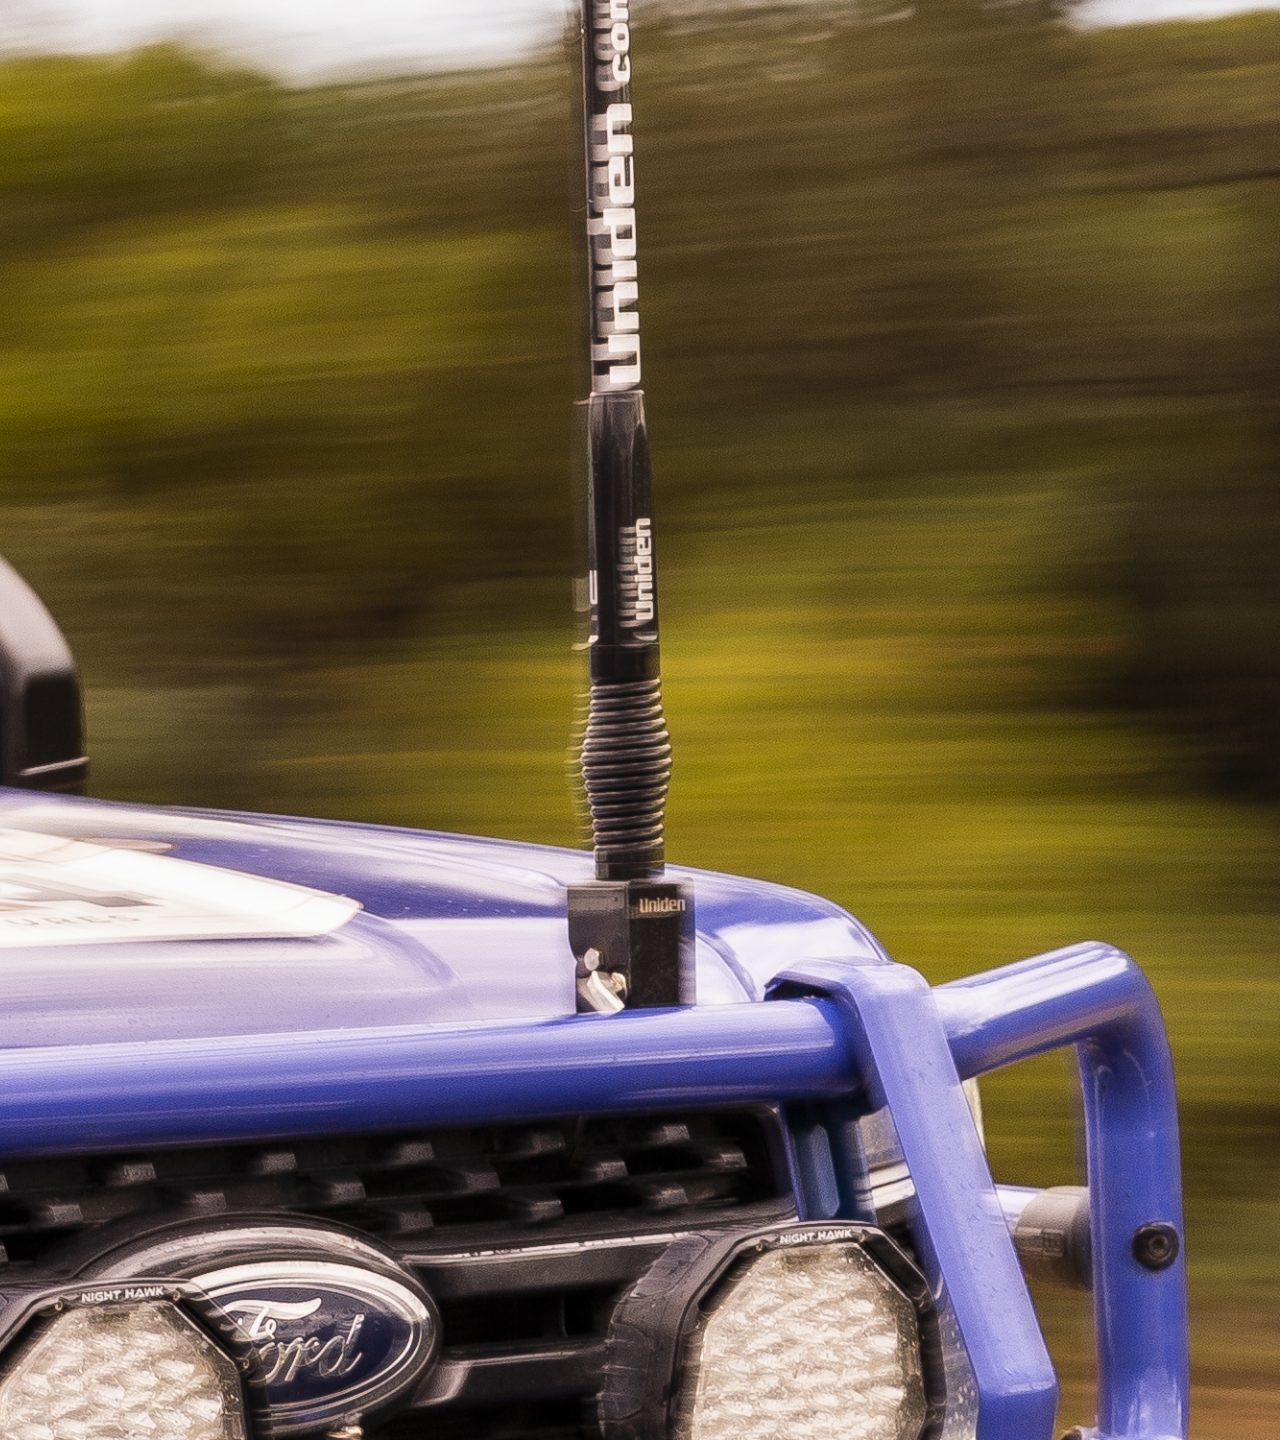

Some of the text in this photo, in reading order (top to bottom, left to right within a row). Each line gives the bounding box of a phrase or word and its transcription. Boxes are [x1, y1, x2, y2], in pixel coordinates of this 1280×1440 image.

[639, 897, 686, 914] Uniden
[779, 1228, 853, 1245] NIGHT HAWK
[81, 1285, 165, 1303] NIGHT HAWK
[224, 1297, 365, 1386] Ford
